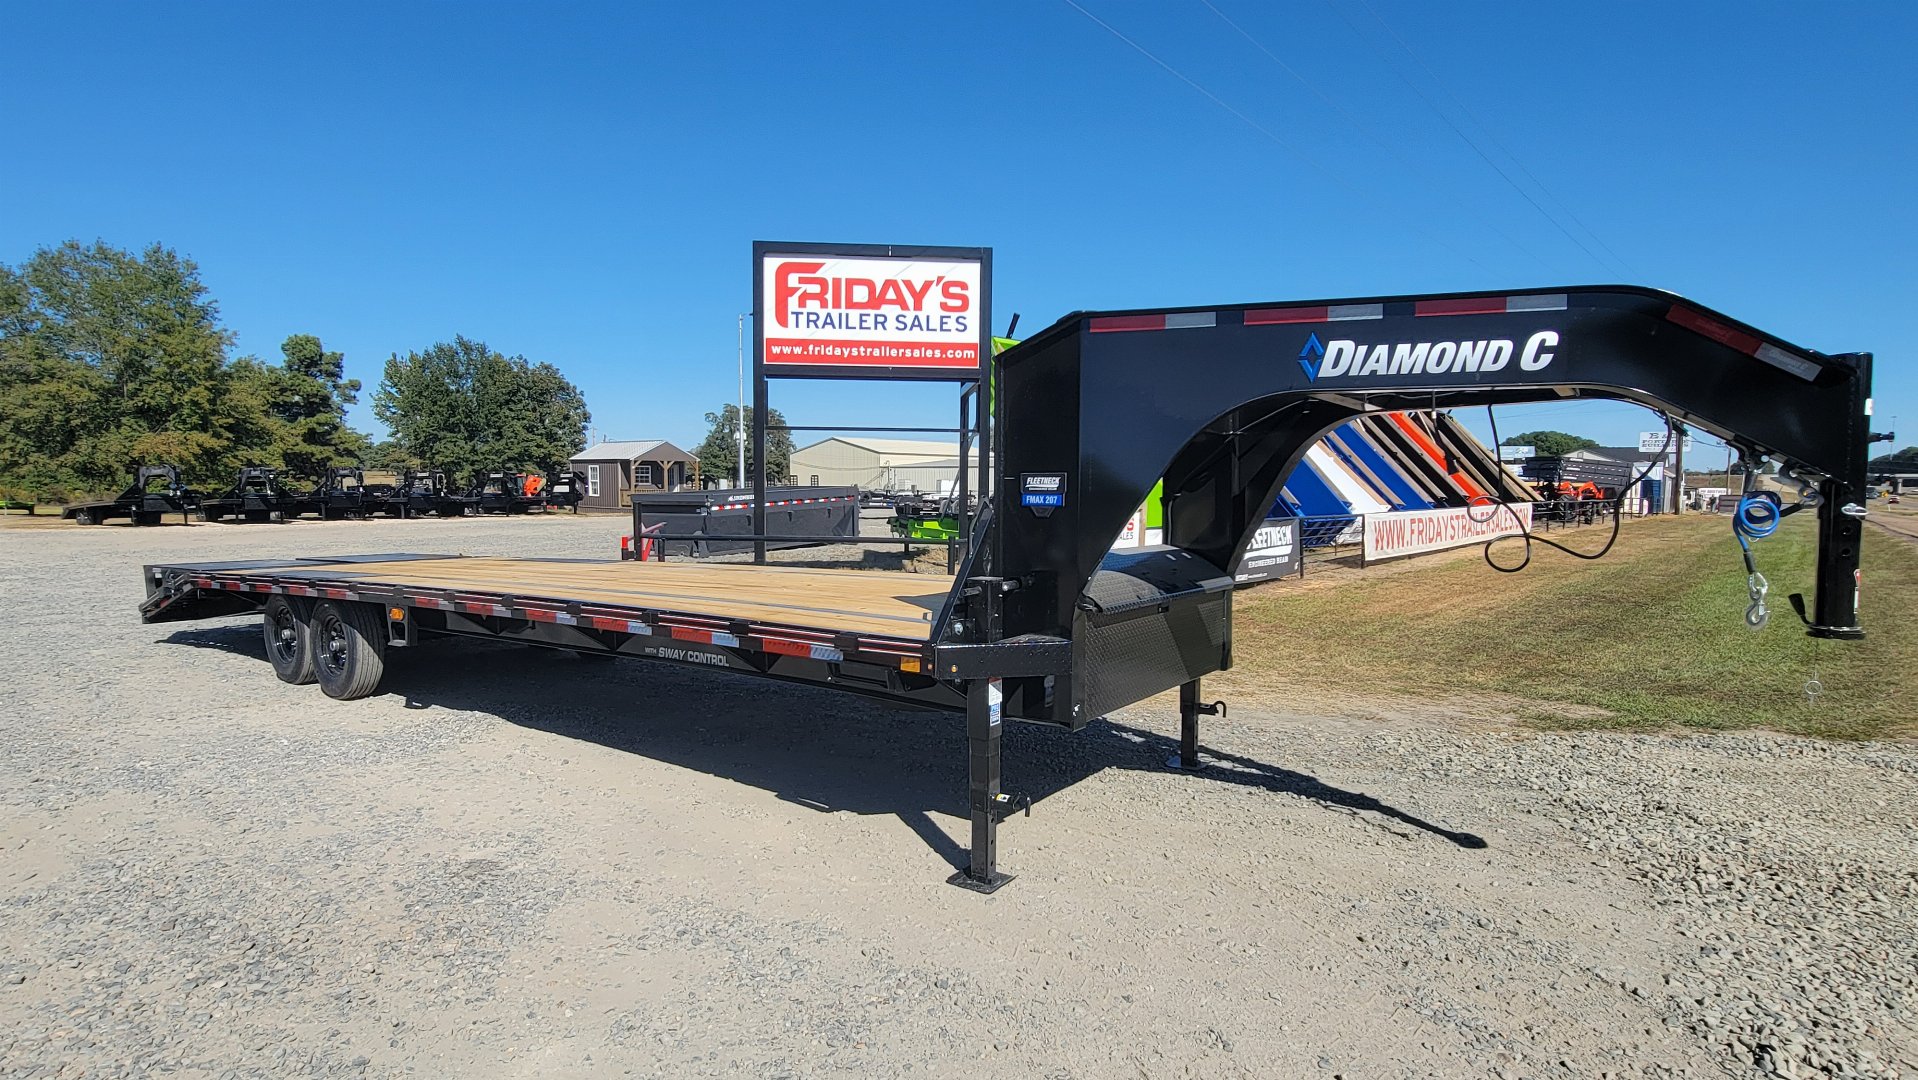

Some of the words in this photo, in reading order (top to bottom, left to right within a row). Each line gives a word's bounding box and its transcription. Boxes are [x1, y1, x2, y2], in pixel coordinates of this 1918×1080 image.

[775, 261, 970, 328] FRIDAY'S
[791, 311, 888, 331] TRAILER
[895, 314, 968, 333] SALES
[771, 343, 975, 360] www.fridaystrailersales.com
[1317, 339, 1513, 378] DIAMOND
[1520, 330, 1559, 372] C
[1026, 476, 1062, 485] FLEETNECK
[1026, 495, 1045, 504] FMAX
[1045, 495, 1058, 504] 207
[1246, 525, 1293, 550] LEETNECK
[644, 646, 657, 654] WITH
[658, 647, 686, 661] SWAY
[687, 650, 730, 667] CONTROL
